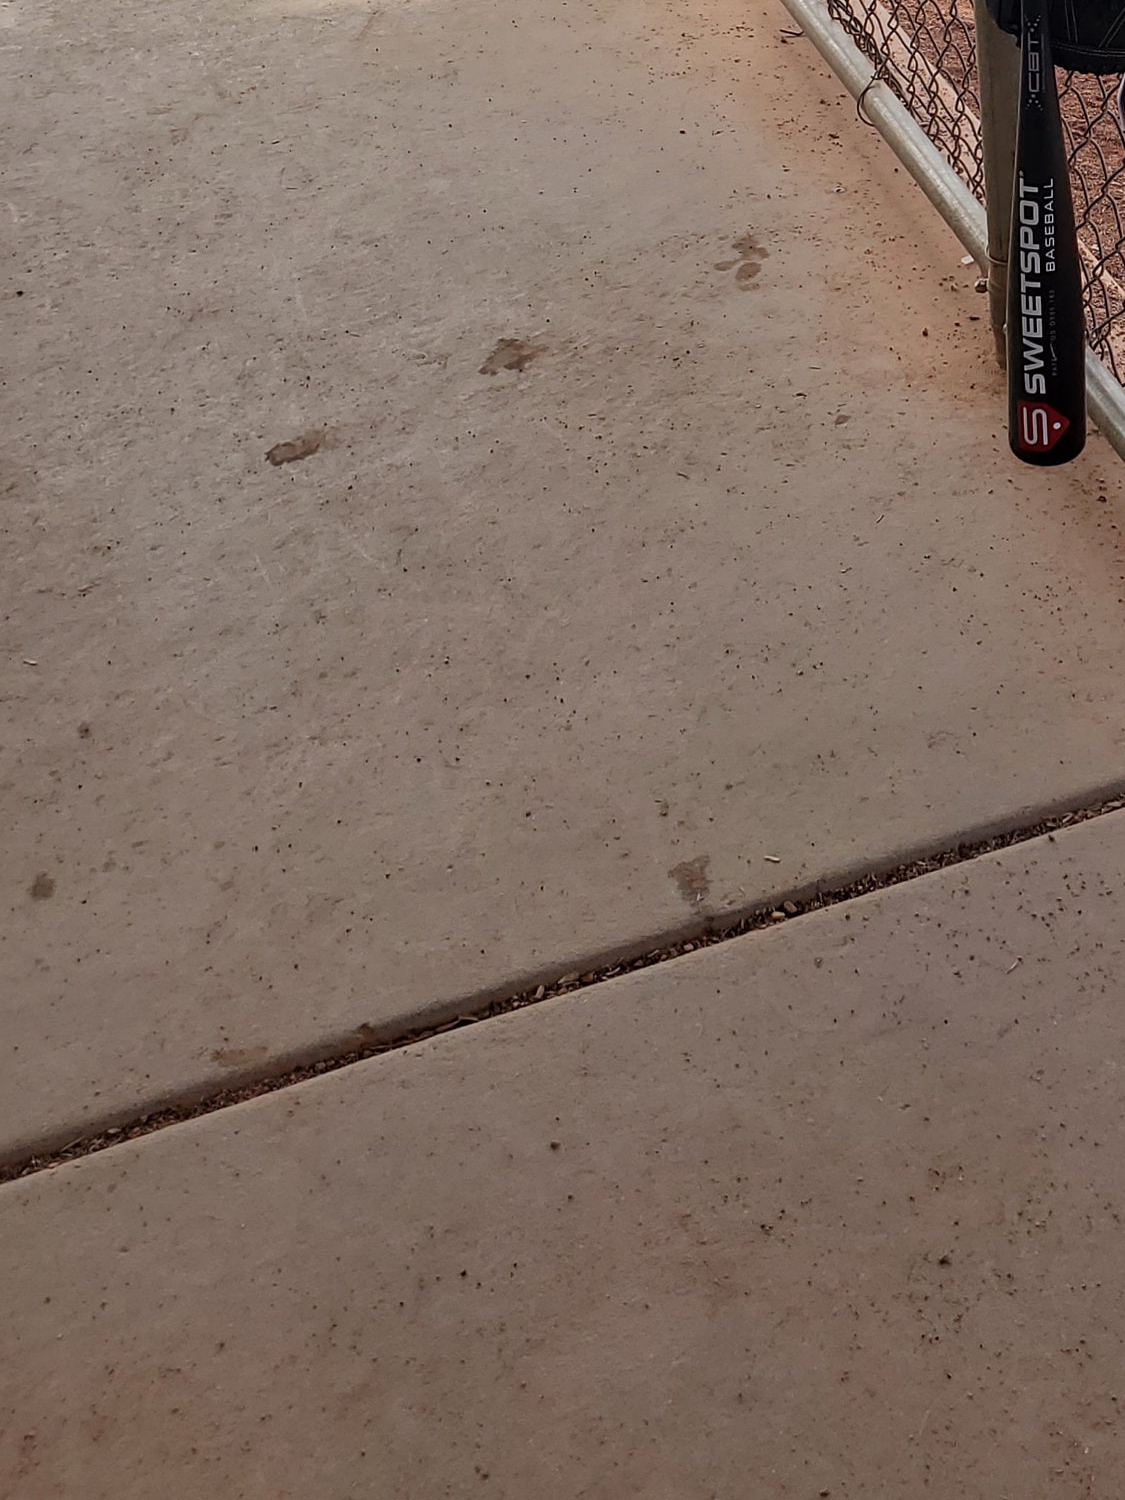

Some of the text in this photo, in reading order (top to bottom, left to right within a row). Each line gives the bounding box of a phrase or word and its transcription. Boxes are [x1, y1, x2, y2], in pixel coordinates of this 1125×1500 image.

[1027, 32, 1040, 93] CBT
[1043, 178, 1056, 273] BASEBALL
[1019, 177, 1047, 395] SWEETSPOT
